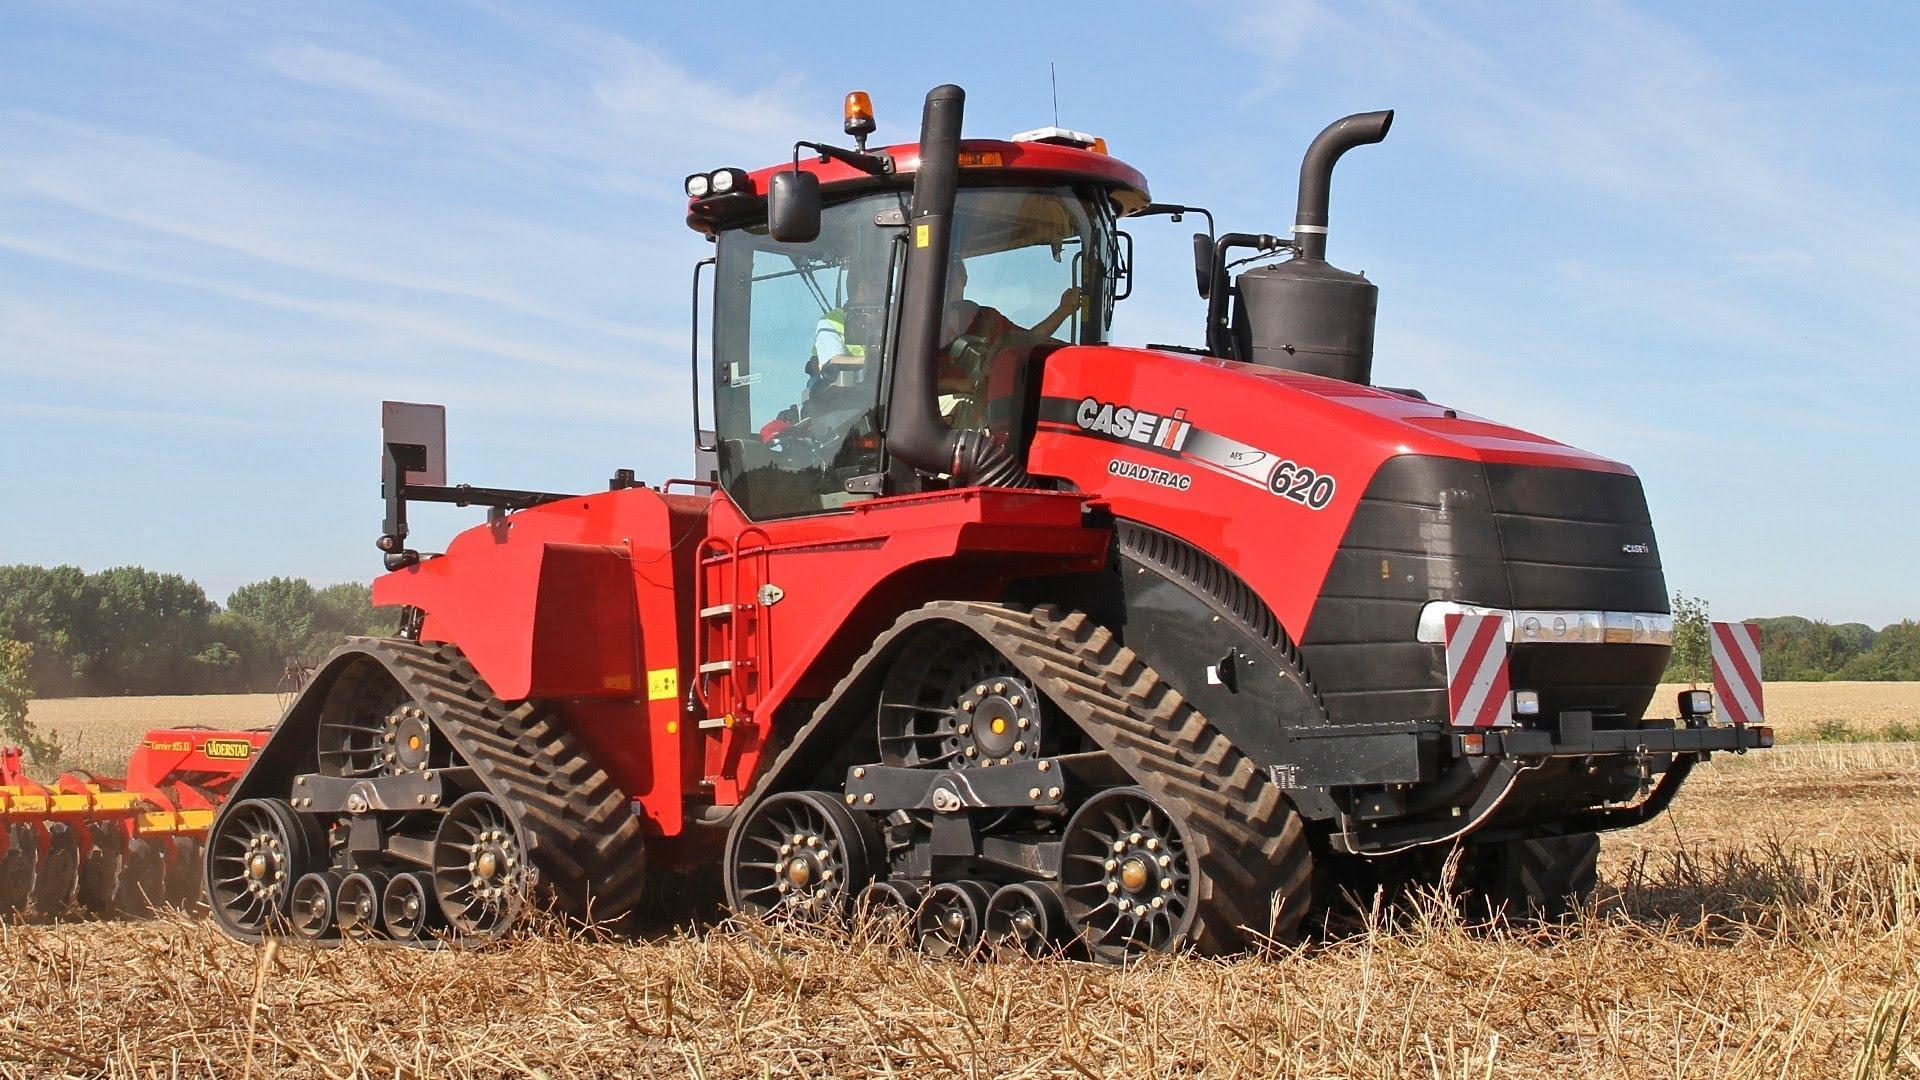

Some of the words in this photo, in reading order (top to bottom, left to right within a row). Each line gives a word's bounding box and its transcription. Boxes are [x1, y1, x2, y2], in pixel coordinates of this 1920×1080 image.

[1077, 398, 1158, 443] CASE
[1230, 451, 1242, 460] AFS
[1108, 461, 1191, 489] QUADTRAC
[1269, 462, 1335, 509] 620
[207, 741, 249, 757] VÄDERSTAD
